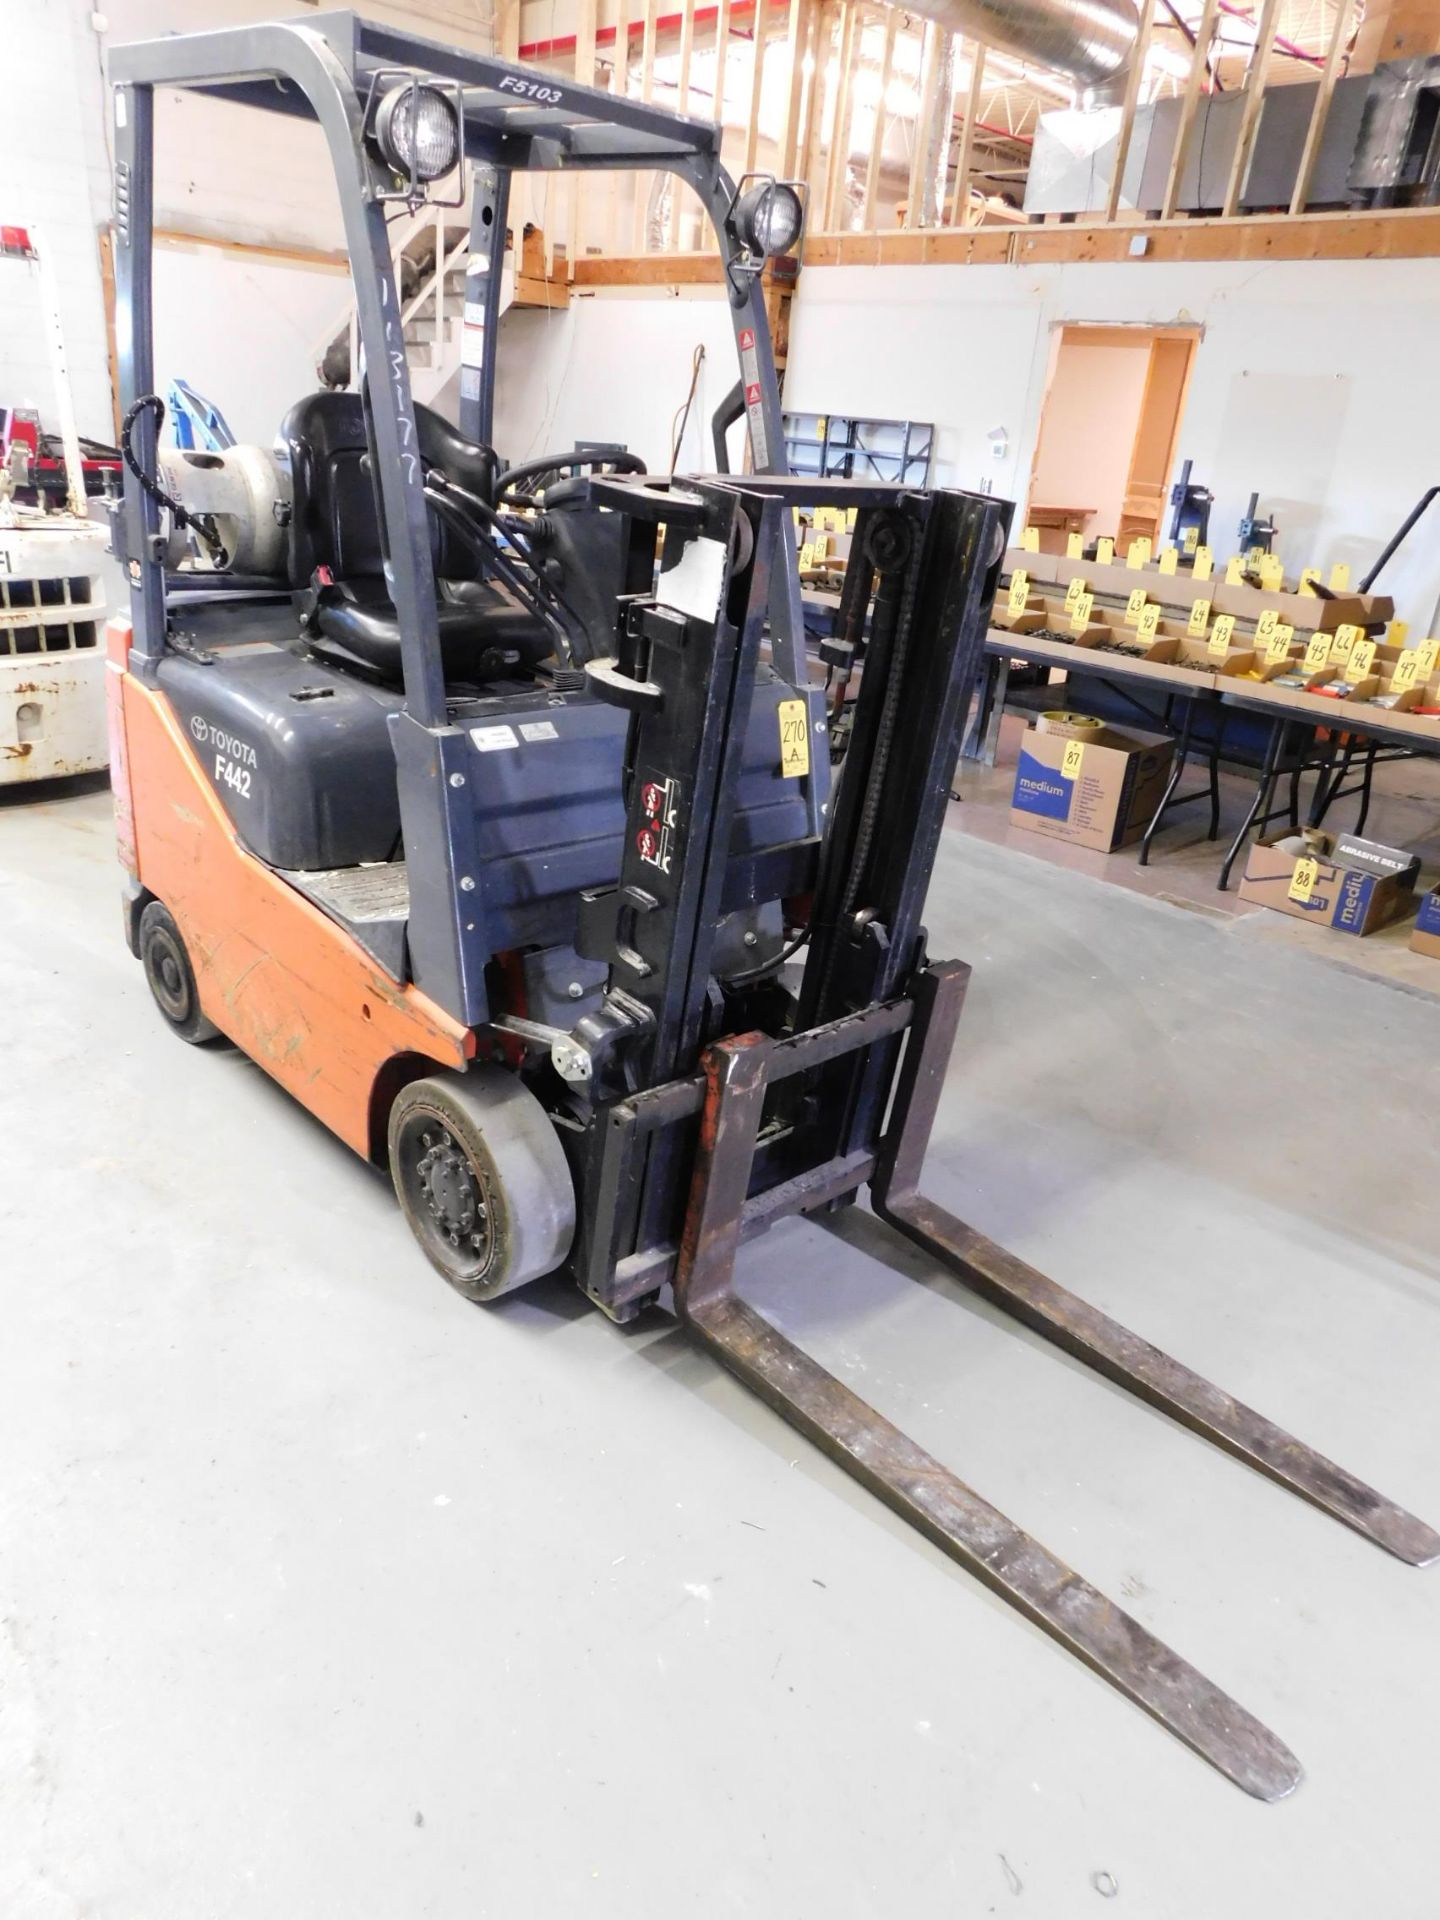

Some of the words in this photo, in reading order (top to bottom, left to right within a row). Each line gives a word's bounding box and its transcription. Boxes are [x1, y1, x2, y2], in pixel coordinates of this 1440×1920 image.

[499, 75, 562, 103] F5103
[1014, 591, 1025, 606] 40
[1077, 603, 1088, 618] 41
[1192, 609, 1205, 623] 64
[1216, 627, 1229, 642] 43
[1259, 621, 1275, 635] 65
[1272, 636, 1288, 653] 44
[1336, 636, 1351, 650] 66
[1311, 644, 1327, 662] 45
[1354, 652, 1368, 670] 46
[1400, 662, 1417, 680] 47
[783, 719, 806, 744] 270
[209, 726, 258, 769] TOYOTA
[790, 747, 800, 762] A
[1066, 751, 1081, 767] 87
[215, 753, 251, 800] F442
[1019, 778, 1064, 797] medium
[1339, 844, 1382, 863] ABRASIVE
[1380, 857, 1404, 871] BELT
[1295, 870, 1311, 888] 88
